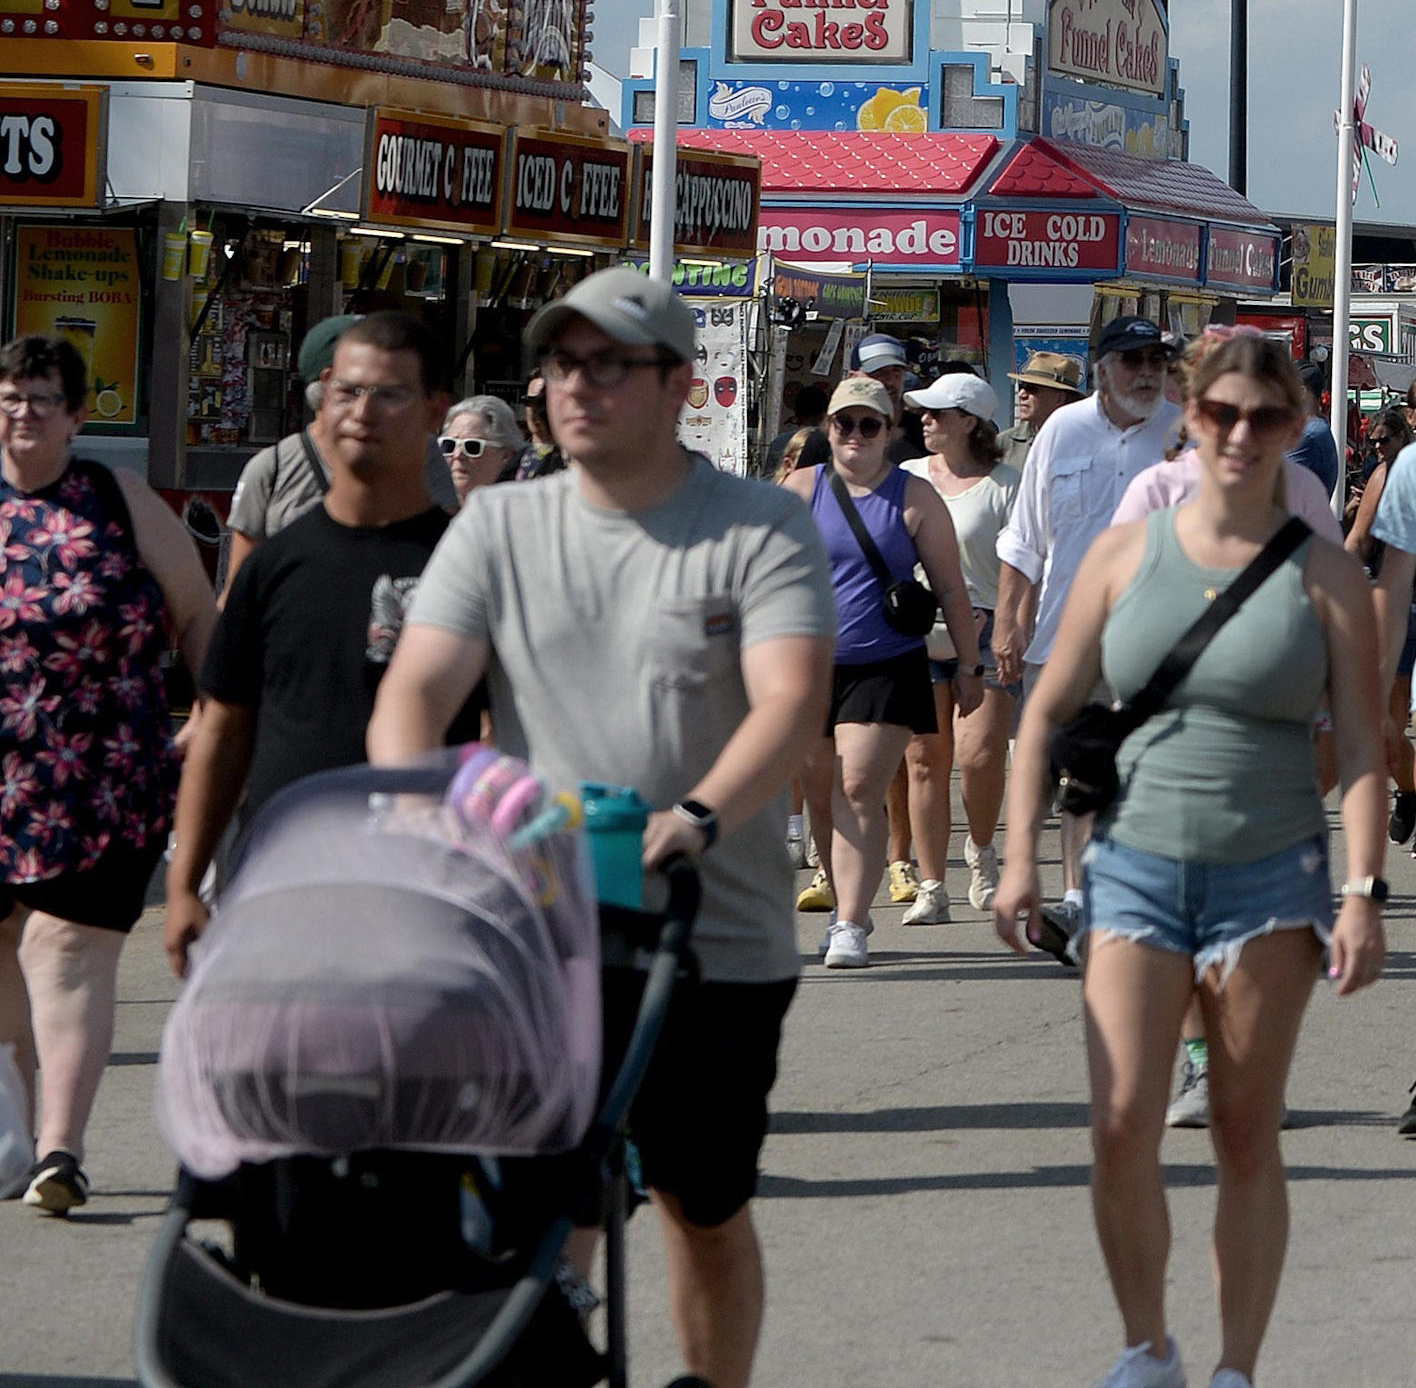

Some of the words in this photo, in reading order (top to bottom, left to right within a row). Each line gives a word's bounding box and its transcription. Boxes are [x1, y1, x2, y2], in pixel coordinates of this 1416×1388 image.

[1060, 7, 1111, 74] Funnel
[376, 133, 442, 198] GOURMET
[515, 153, 556, 211] ICED
[46, 230, 114, 249] Bubble
[758, 219, 957, 256] monade
[983, 212, 1027, 238] ICE
[1046, 215, 1106, 241] COLD
[28, 244, 131, 263] Lemonade
[1007, 240, 1079, 267] DRINKS
[1141, 228, 1199, 271] Lemonade
[28, 264, 130, 286] Shake-ups
[23, 289, 84, 305] Bursting
[88, 290, 132, 304] BOBA
